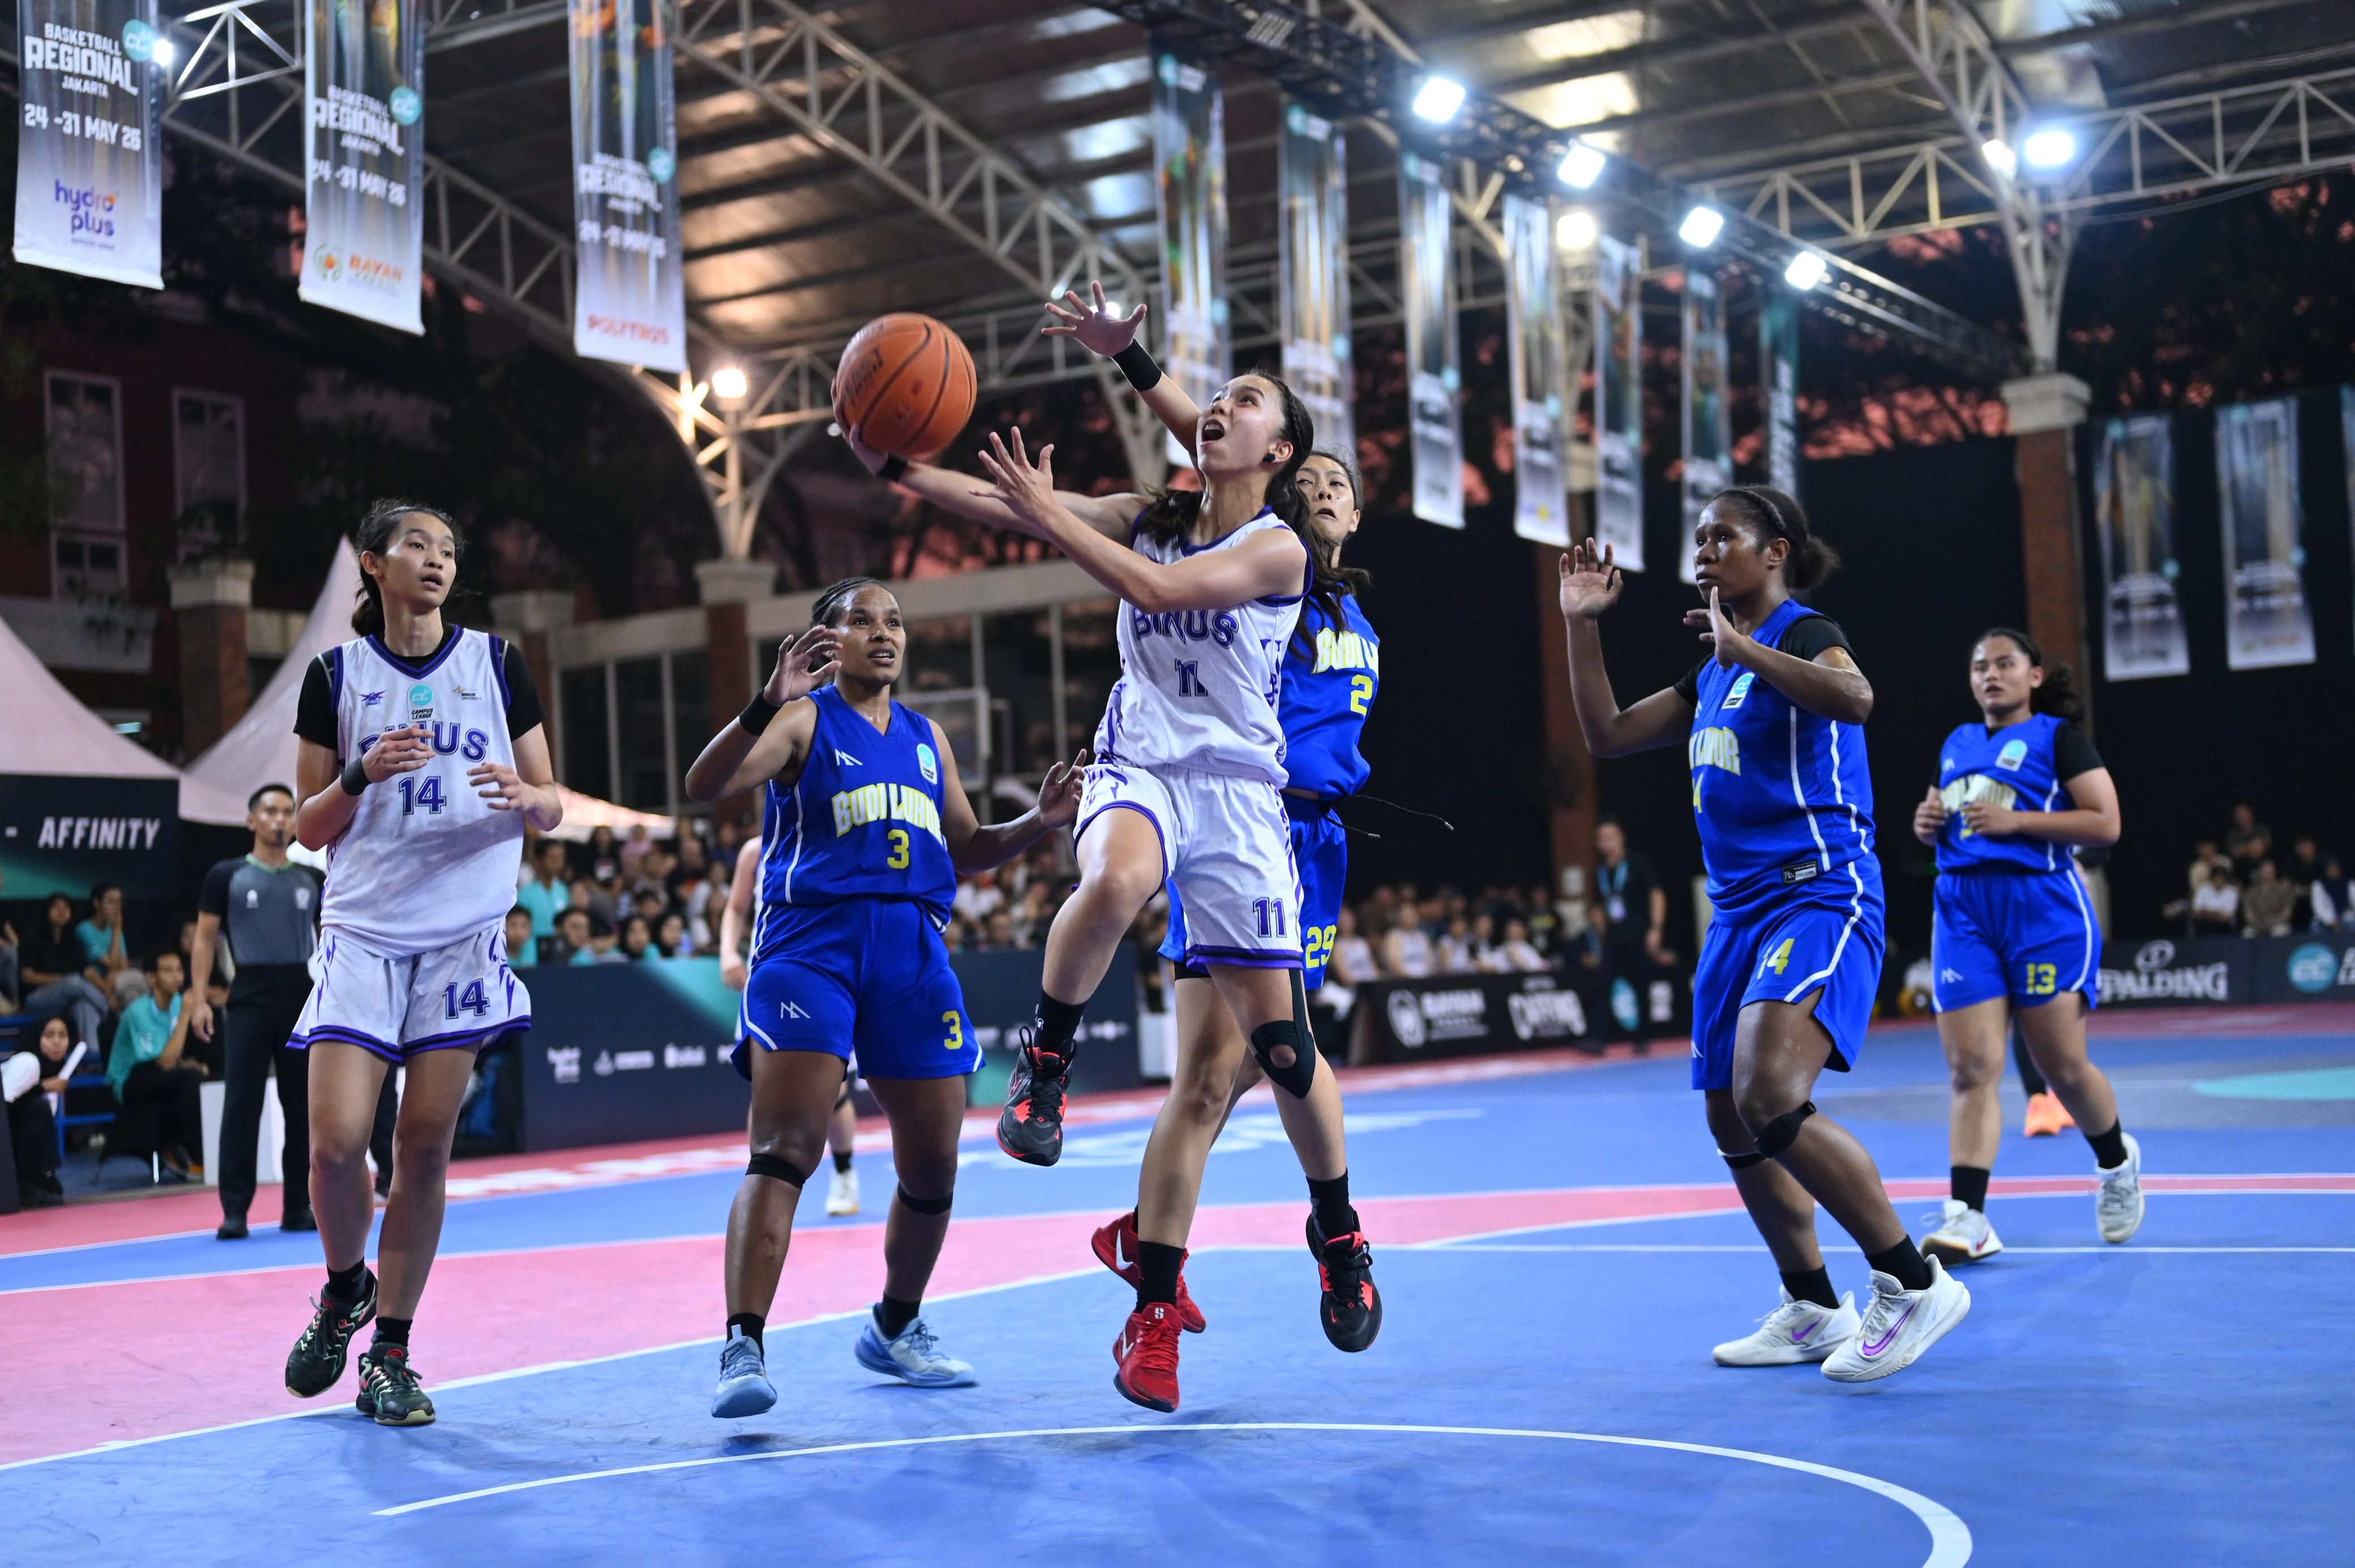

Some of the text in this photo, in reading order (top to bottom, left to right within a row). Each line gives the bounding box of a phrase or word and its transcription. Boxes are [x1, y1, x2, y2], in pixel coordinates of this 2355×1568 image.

[45, 22, 122, 57] BASKETBALL
[24, 35, 139, 96] REGIONAL
[62, 75, 108, 98] JAKARTA
[24, 103, 49, 129] 24
[85, 115, 119, 144] MAY
[314, 97, 405, 156] REGIONAL
[55, 179, 117, 212] hydro
[71, 212, 114, 236] plus
[1133, 606, 1239, 649] BINUS
[1311, 627, 1366, 674] BUDI
[399, 776, 447, 816] 14
[831, 783, 888, 838] BUDI
[37, 816, 161, 850] AFFINITY
[887, 829, 909, 869] 3
[1253, 897, 1287, 938] 11
[1305, 924, 1337, 969] 29
[442, 978, 490, 1019] 14
[2026, 963, 2056, 995] 13
[942, 1010, 964, 1050] 3
